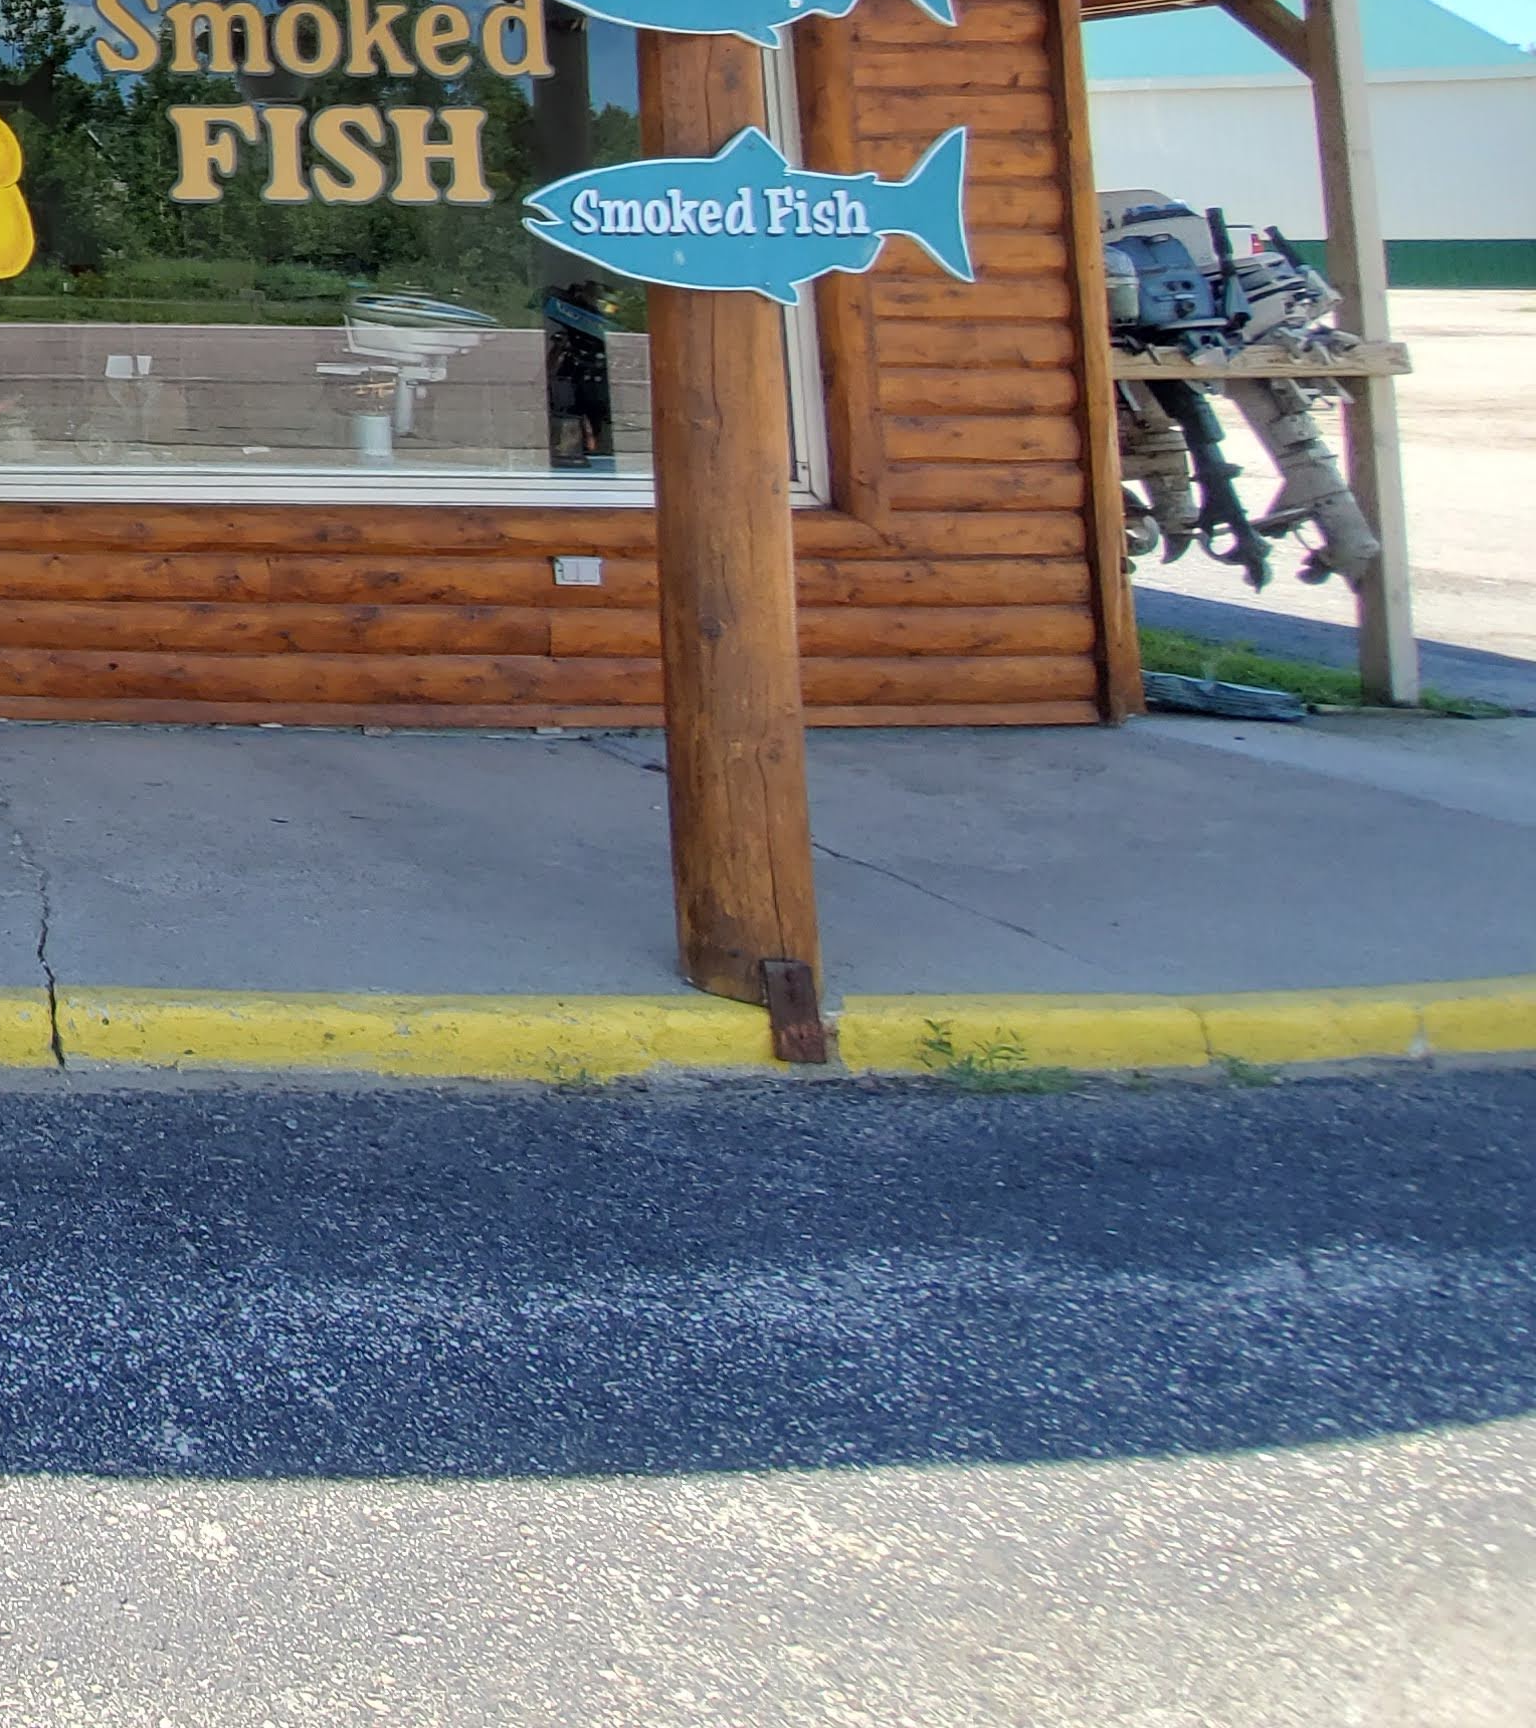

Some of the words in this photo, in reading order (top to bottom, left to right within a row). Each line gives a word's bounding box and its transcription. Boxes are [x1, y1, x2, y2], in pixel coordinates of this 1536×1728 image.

[167, 103, 496, 206] FISH
[570, 187, 756, 237] Smoked
[764, 186, 871, 238] Fish
